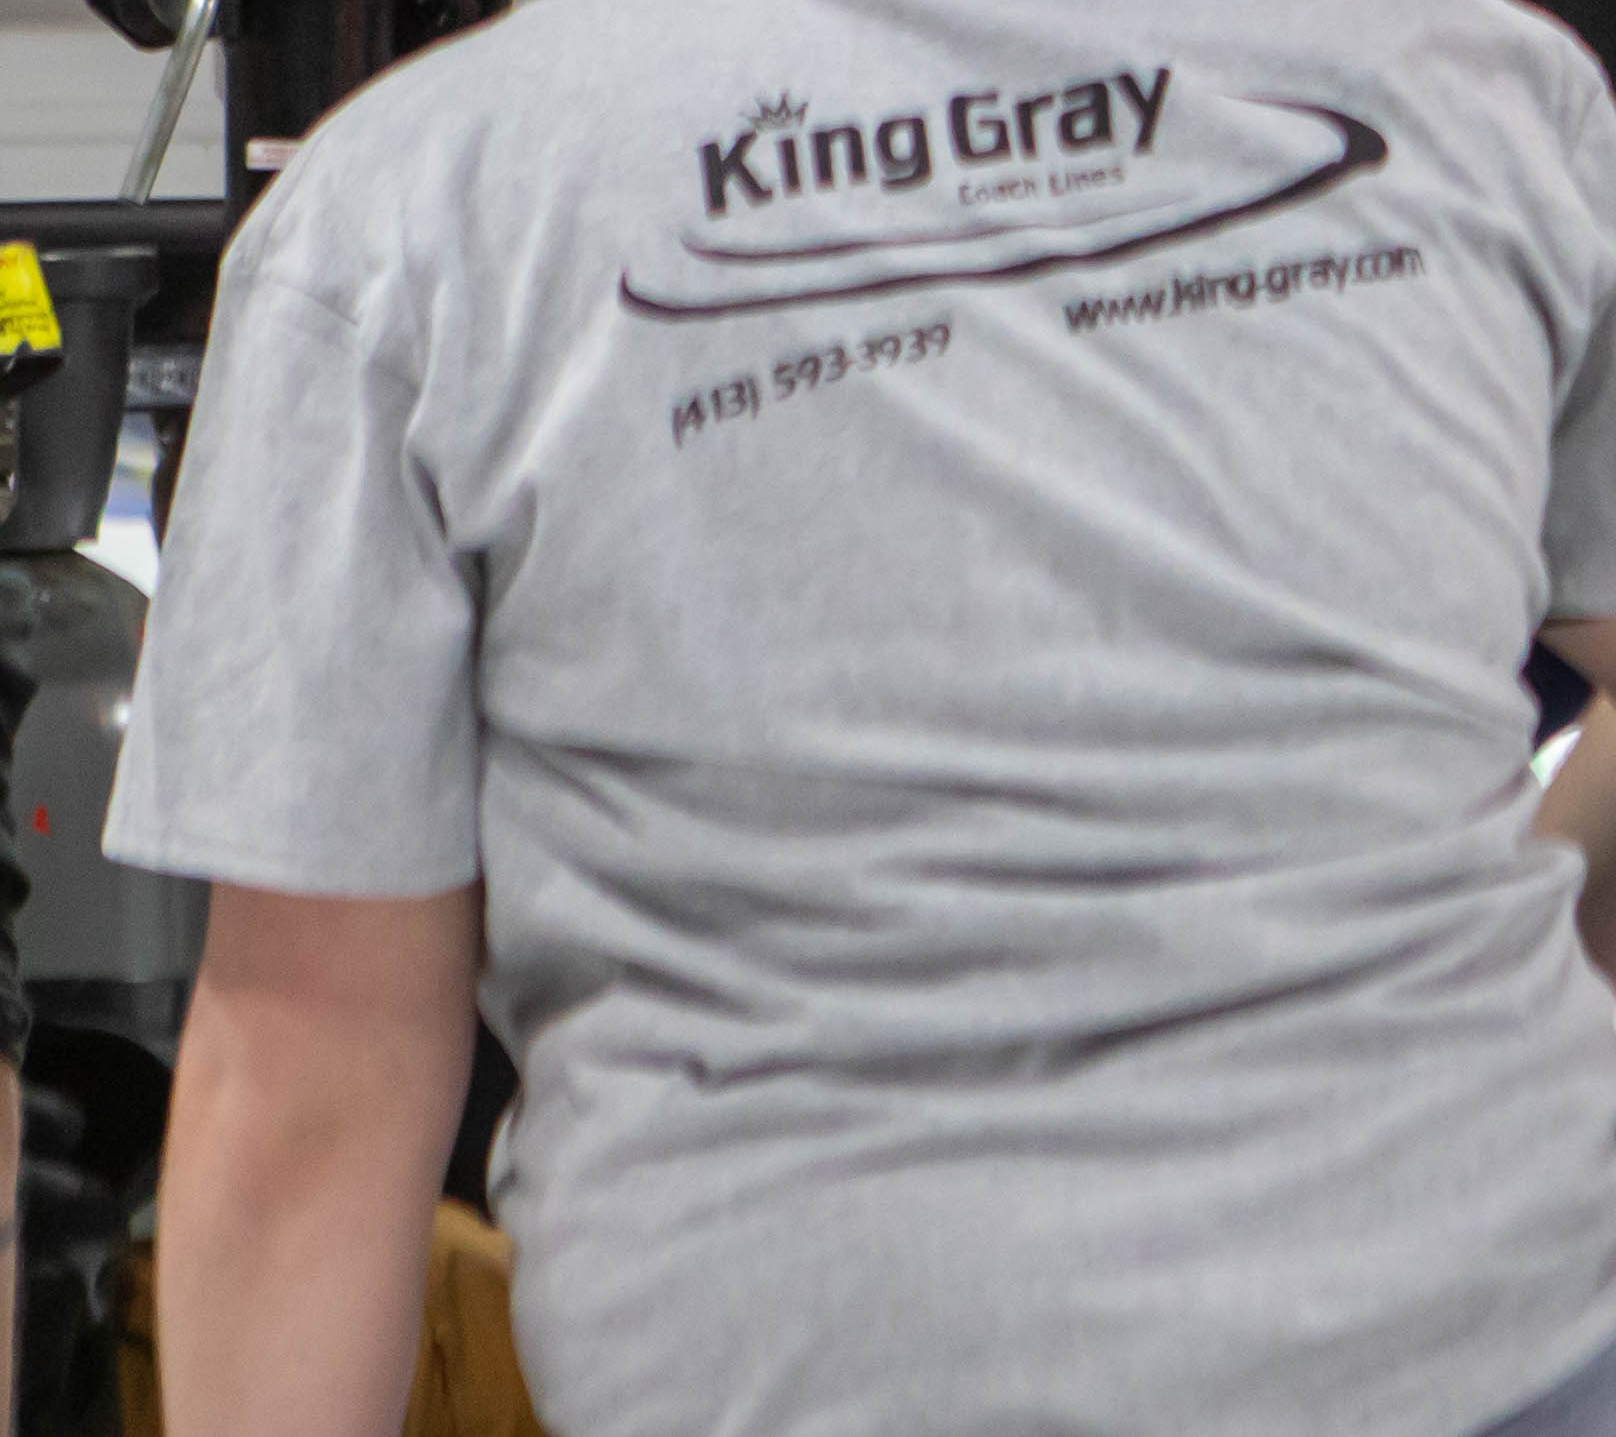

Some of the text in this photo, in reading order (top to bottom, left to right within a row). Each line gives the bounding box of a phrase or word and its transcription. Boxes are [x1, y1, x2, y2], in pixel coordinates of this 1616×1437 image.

[697, 65, 1172, 220] King Gray
[671, 373, 762, 449] (413)
